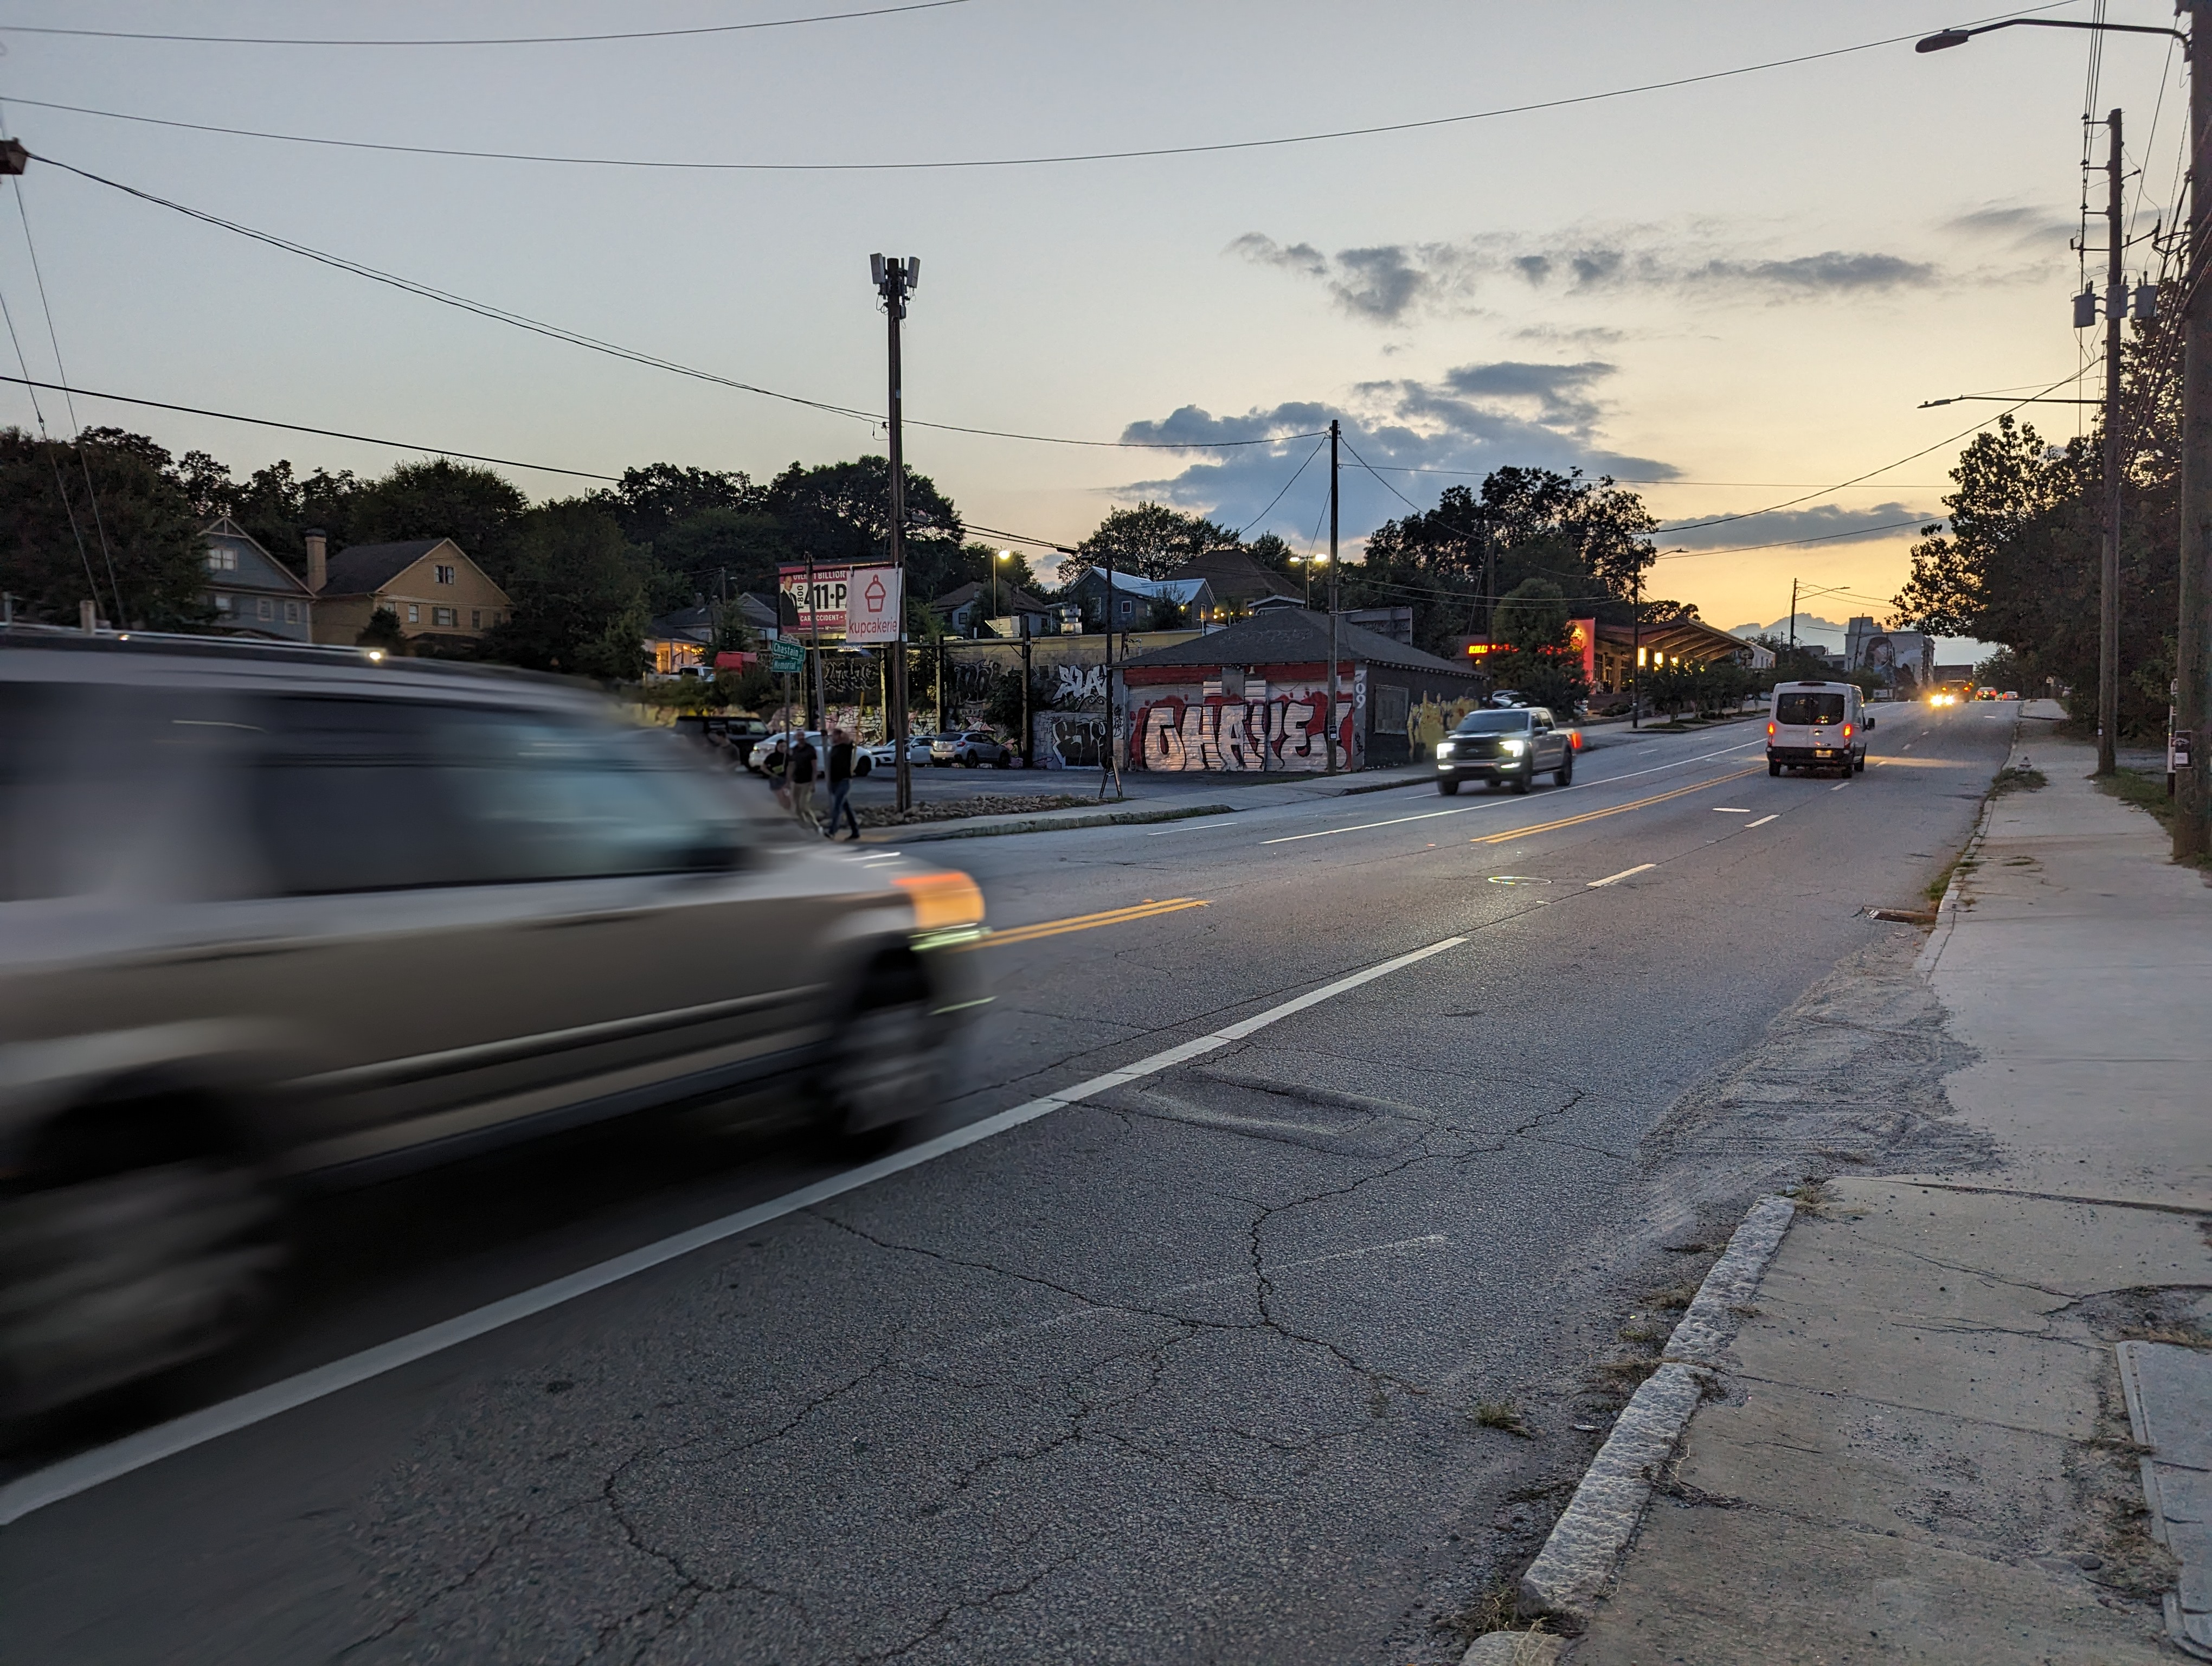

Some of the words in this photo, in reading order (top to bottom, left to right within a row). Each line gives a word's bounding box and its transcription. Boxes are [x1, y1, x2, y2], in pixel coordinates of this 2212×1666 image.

[818, 571, 846, 579] BILLION
[848, 617, 897, 637] kupcakerie
[774, 643, 799, 657] Chastain
[774, 660, 796, 670] Memorial
